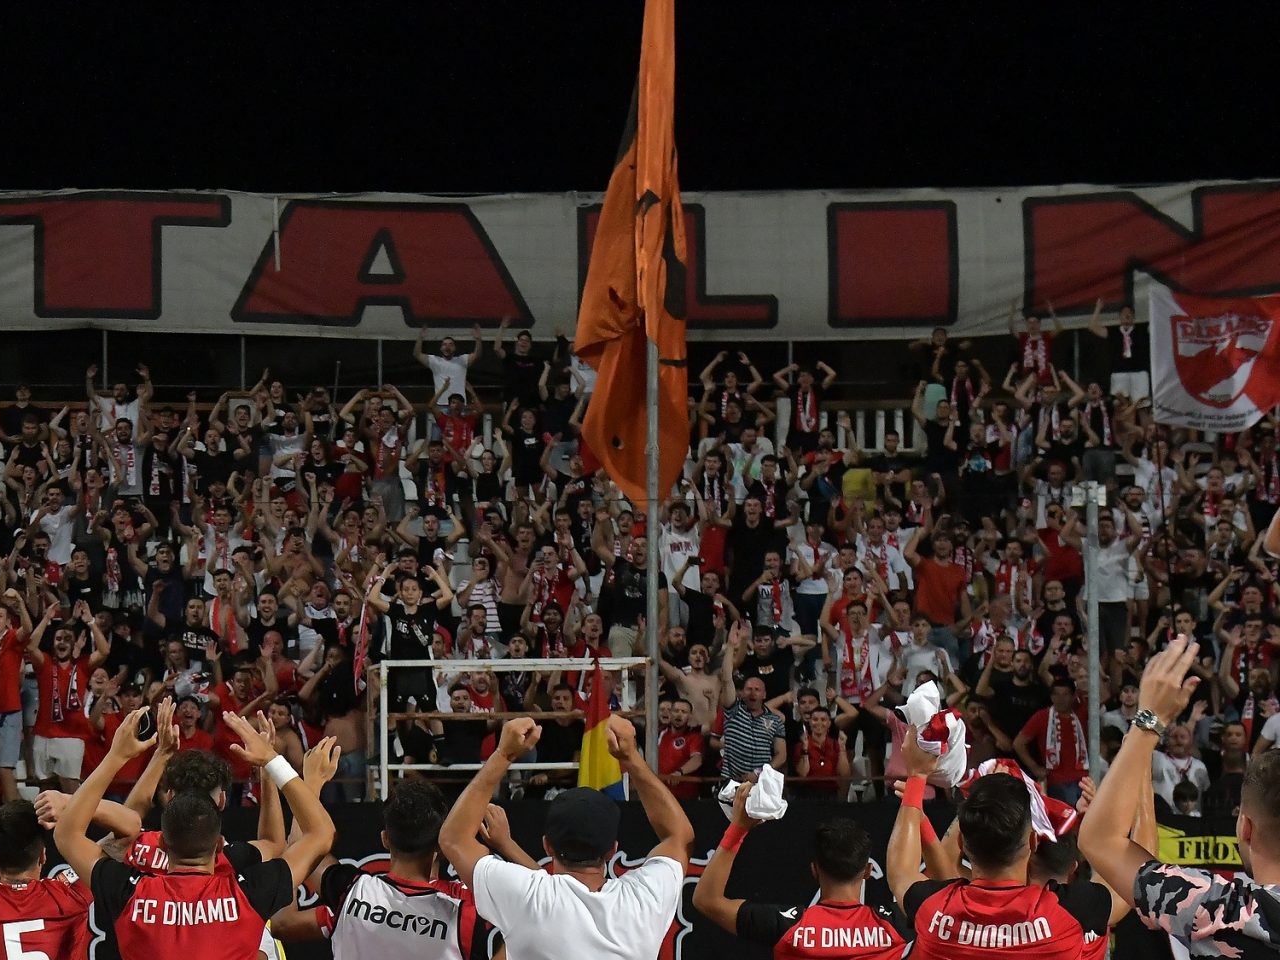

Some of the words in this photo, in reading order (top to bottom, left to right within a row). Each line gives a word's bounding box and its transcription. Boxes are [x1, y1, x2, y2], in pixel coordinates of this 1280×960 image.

[136, 844, 150, 866] FC
[131, 899, 158, 925] FC
[162, 897, 239, 926] DINAMO
[347, 898, 448, 940] macron
[928, 910, 955, 941] FC
[792, 927, 816, 948] FC
[821, 926, 892, 948] DINAMO
